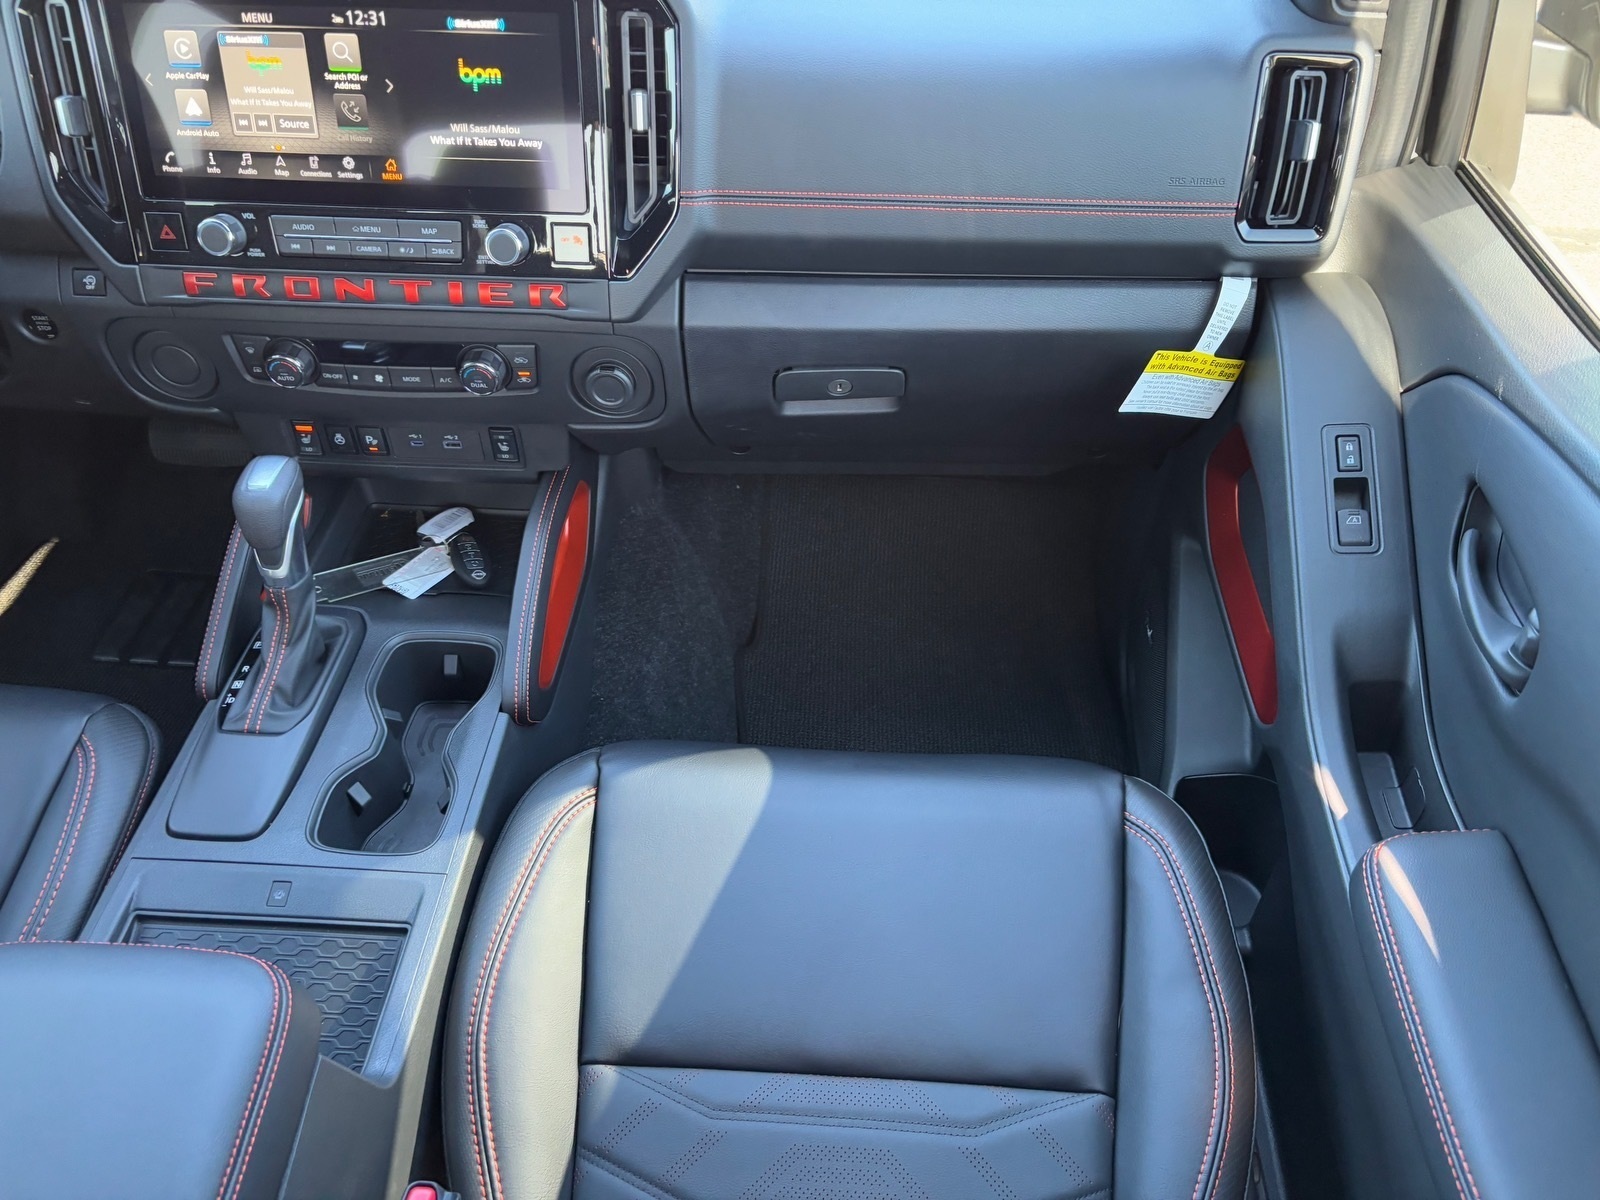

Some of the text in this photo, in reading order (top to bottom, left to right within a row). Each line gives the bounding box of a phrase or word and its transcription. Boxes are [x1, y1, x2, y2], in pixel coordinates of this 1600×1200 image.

[241, 12, 273, 24] MENU
[346, 11, 386, 27] 12:31
[166, 72, 210, 82] Apple CarPlay
[324, 72, 346, 81] Search
[458, 58, 502, 92] bpm
[244, 86, 294, 95] Will Sass/Malou
[334, 82, 361, 90] Address
[230, 98, 249, 106] What
[261, 98, 280, 107] Takes
[294, 100, 312, 109] Away
[280, 119, 310, 129] Source
[176, 129, 220, 138] Android Auto
[450, 123, 520, 135] Will Sass/Malou
[430, 136, 543, 150] What If It Takes You Away
[162, 165, 183, 174] Phone
[207, 166, 221, 174] Info
[238, 167, 258, 176] Audio
[274, 169, 290, 178] Map
[300, 170, 332, 178] Connections
[338, 171, 364, 180] Settings
[382, 172, 402, 181] MENU
[1168, 176, 1226, 186] SRS AIRBAG
[360, 226, 382, 234] MENU
[421, 227, 438, 235] MAP
[182, 271, 566, 308] FRONTIER
[1172, 354, 1198, 363] Vehicle
[1210, 360, 1243, 370] Equipped
[1167, 363, 1205, 374] Advanced
[1218, 370, 1236, 380] Bags
